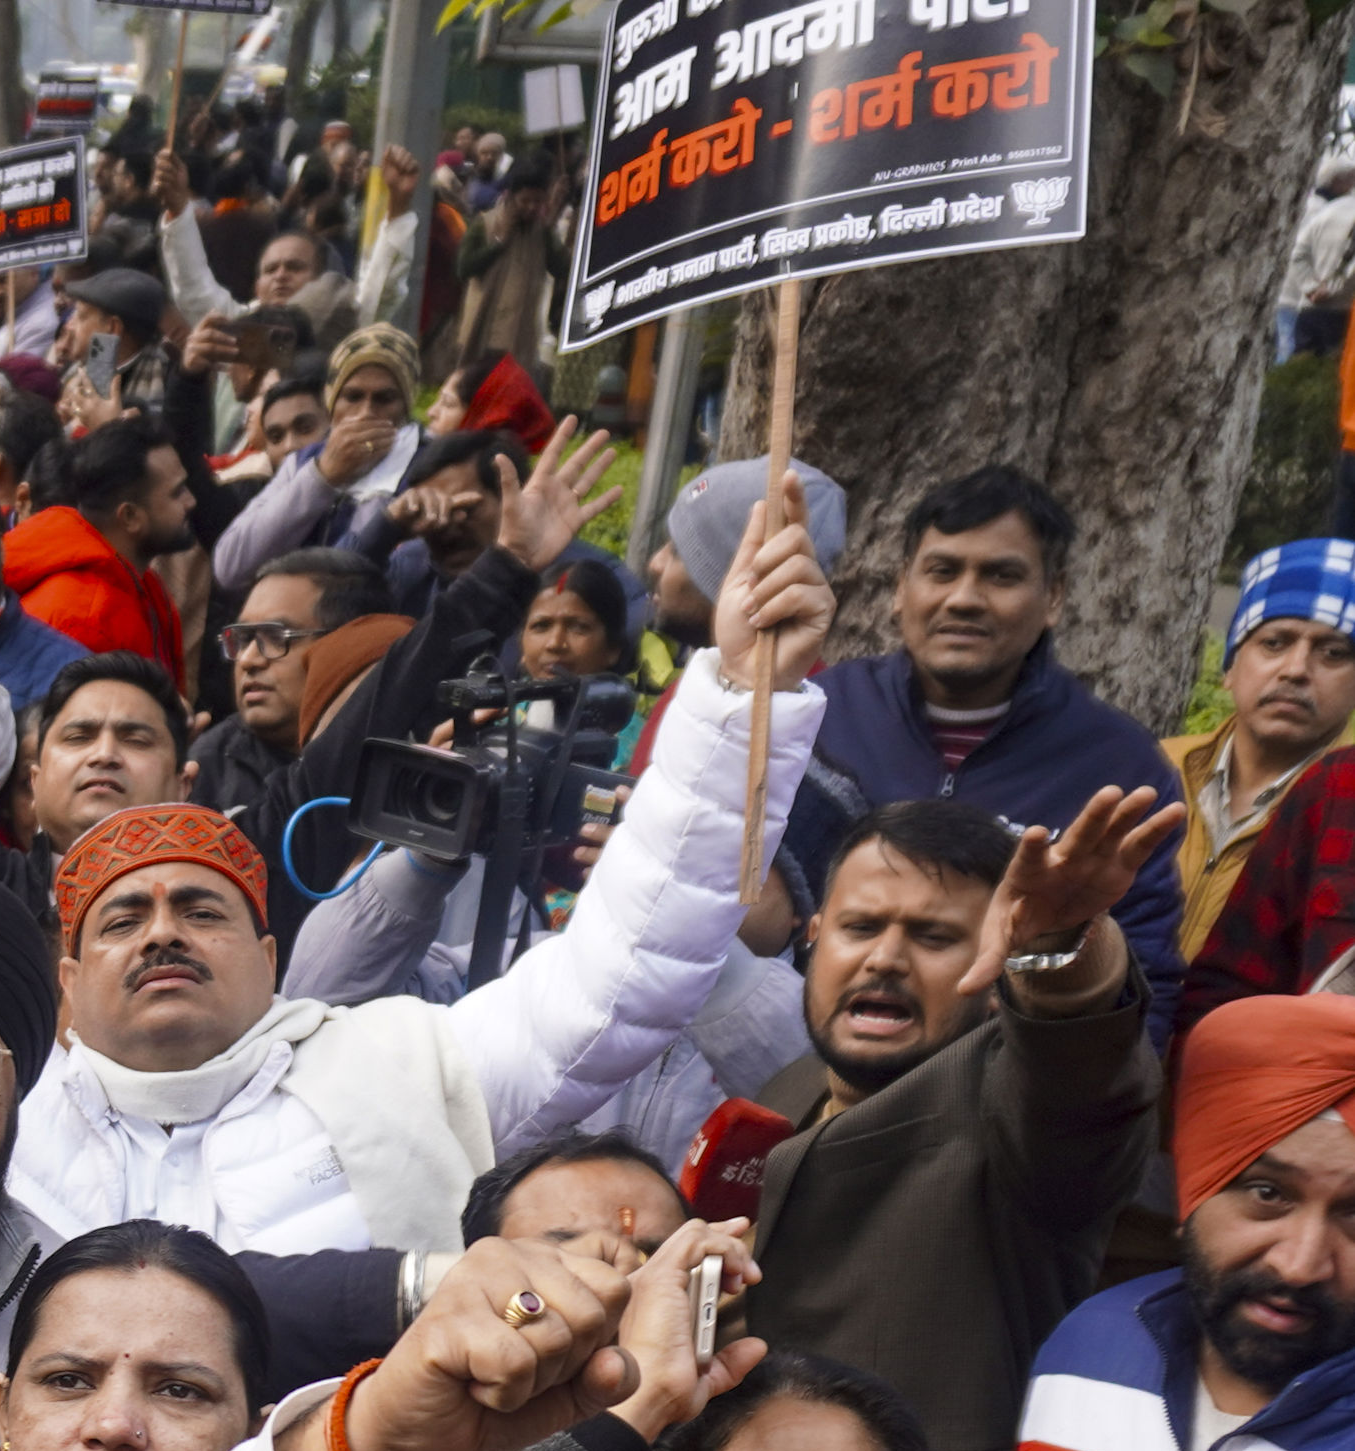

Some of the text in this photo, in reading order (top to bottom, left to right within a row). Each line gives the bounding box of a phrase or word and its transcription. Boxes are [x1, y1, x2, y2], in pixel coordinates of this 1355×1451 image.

[596, 127, 669, 227] शर्म
[669, 97, 763, 188] करो
[808, 50, 923, 146] शर्म
[928, 32, 1059, 119] करो
[609, 46, 697, 140] आम
[951, 157, 979, 169] Print
[981, 153, 1002, 164] Ads
[613, 266, 670, 308] भारतीय
[669, 251, 718, 288] जनता
[759, 227, 812, 259] सिख
[879, 197, 949, 236] दिल्ली
[949, 192, 1004, 223] प्रदेश
